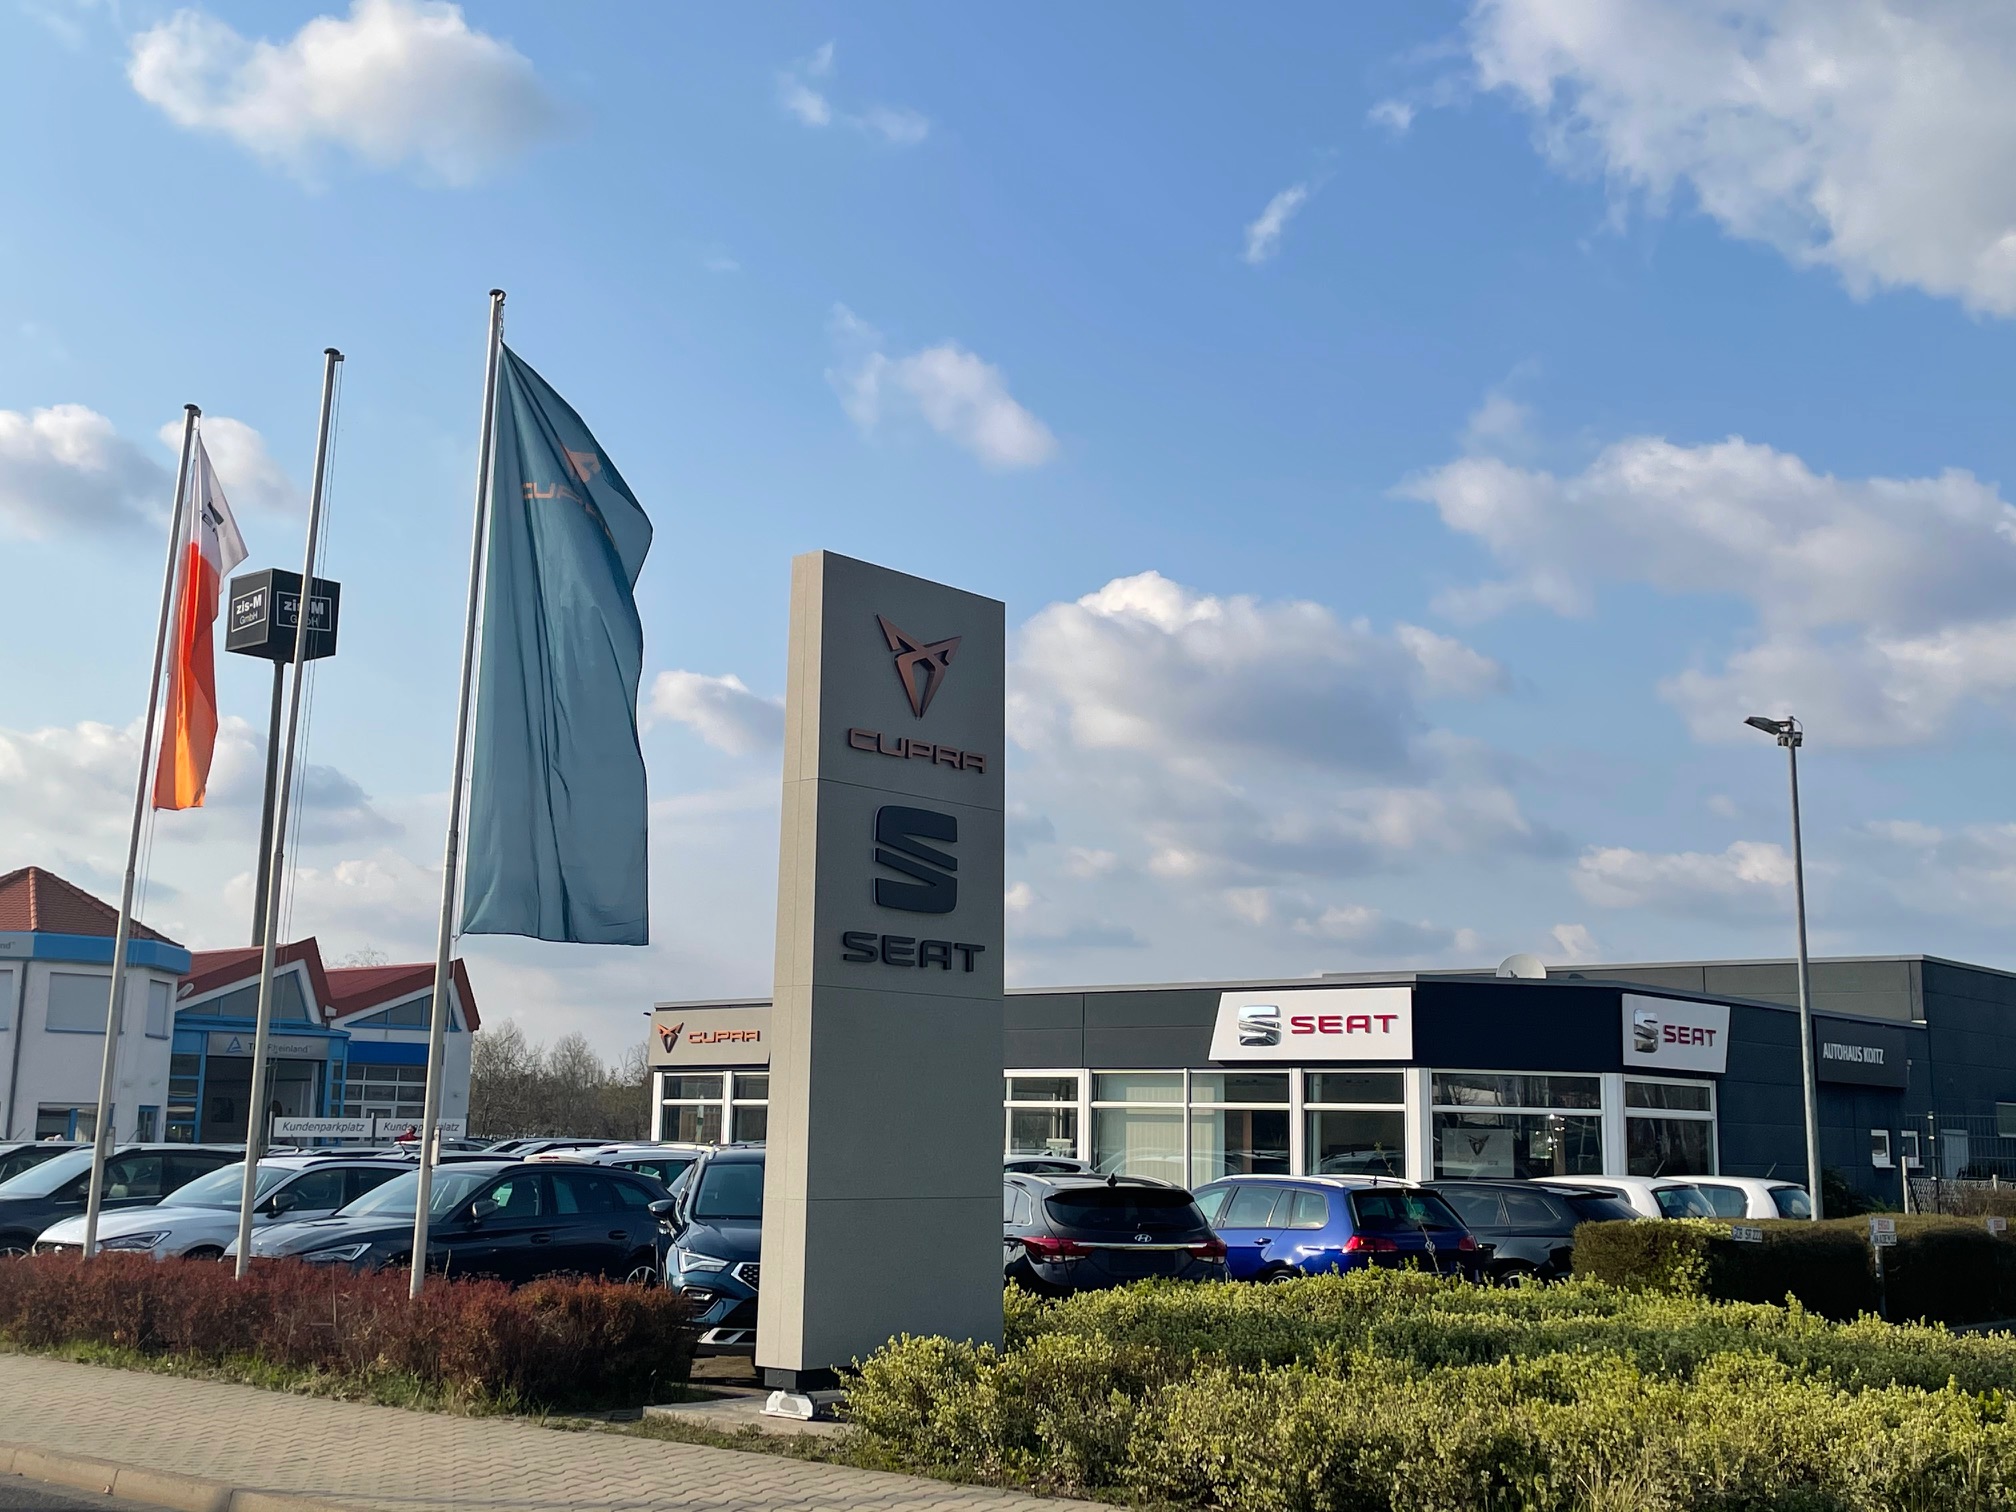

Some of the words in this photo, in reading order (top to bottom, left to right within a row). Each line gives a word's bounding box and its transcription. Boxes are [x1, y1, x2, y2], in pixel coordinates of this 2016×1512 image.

[236, 594, 263, 615] zis-M
[239, 610, 258, 625] GmbH
[848, 727, 987, 774] CUPRA
[842, 931, 986, 972] SEAT
[1290, 1014, 1399, 1035] SEAT
[688, 1029, 761, 1044] CUPRA
[1663, 1024, 1717, 1047] SEAT
[1823, 1042, 1863, 1062] AUTOHAUS
[282, 1121, 365, 1134] Kundenparkplatz
